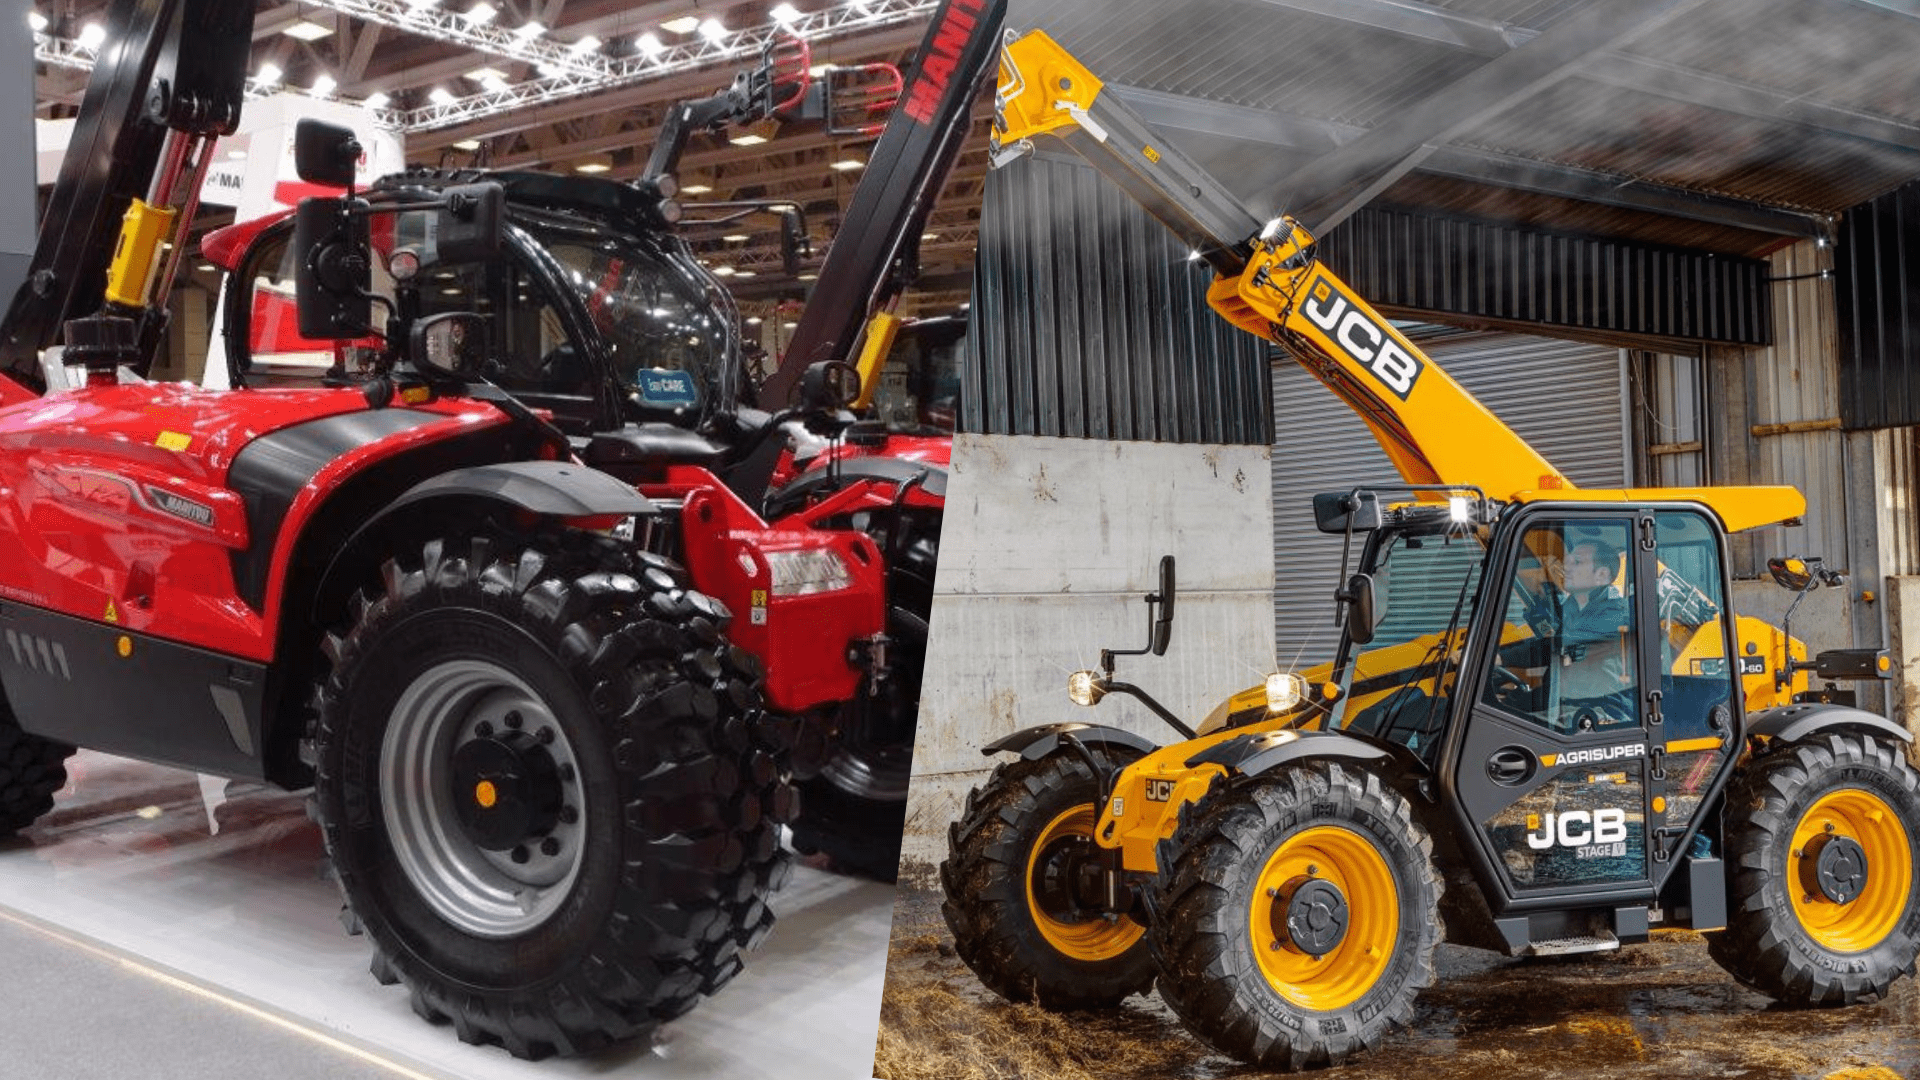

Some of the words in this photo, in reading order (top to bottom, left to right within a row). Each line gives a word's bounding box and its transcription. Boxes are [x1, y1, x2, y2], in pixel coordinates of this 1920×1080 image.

[1305, 296, 1417, 393] JCB
[166, 496, 211, 524] MANITOU
[1555, 743, 1645, 766] AGRISUPER
[1527, 808, 1627, 850] JCB
[1576, 844, 1612, 860] STAGE
